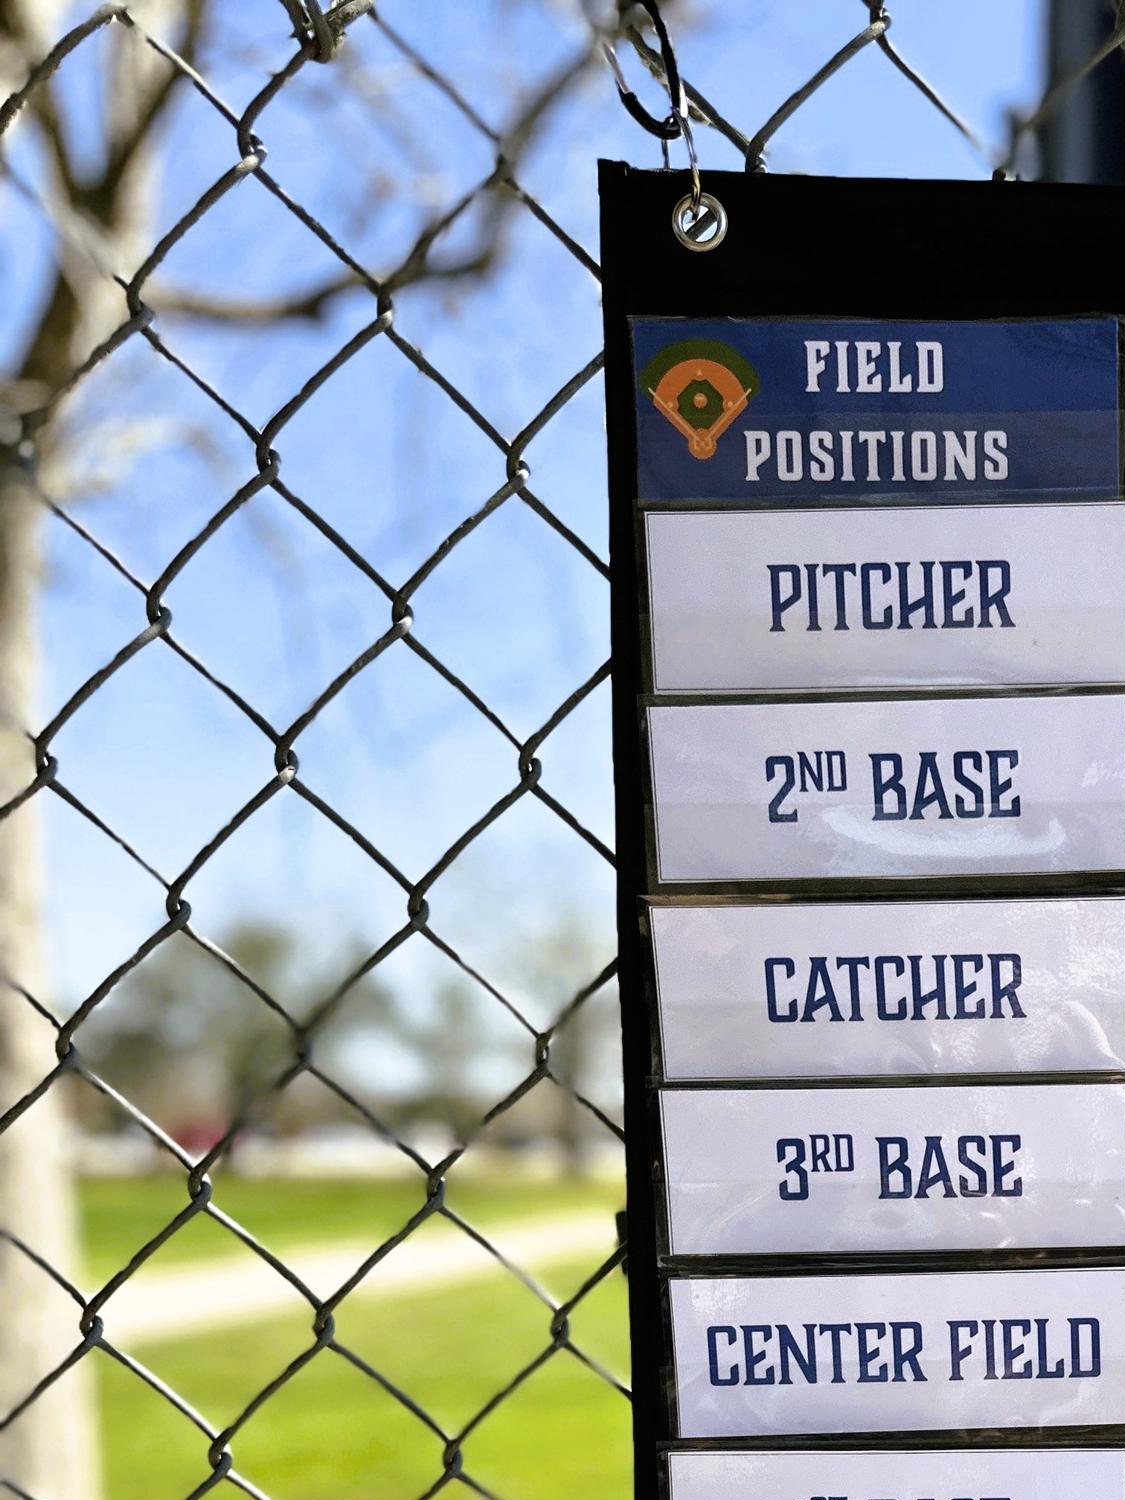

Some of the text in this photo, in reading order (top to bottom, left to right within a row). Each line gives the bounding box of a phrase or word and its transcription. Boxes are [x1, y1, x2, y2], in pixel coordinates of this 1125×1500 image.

[803, 340, 944, 392] FIELD
[743, 430, 1009, 481] POSITIONS
[766, 559, 1016, 632] PITCHER
[867, 749, 1022, 820] BASE
[764, 953, 1028, 1023] CATCHER
[874, 1134, 1023, 1199] BASE
[706, 1317, 1102, 1386] CENTER FIELD
